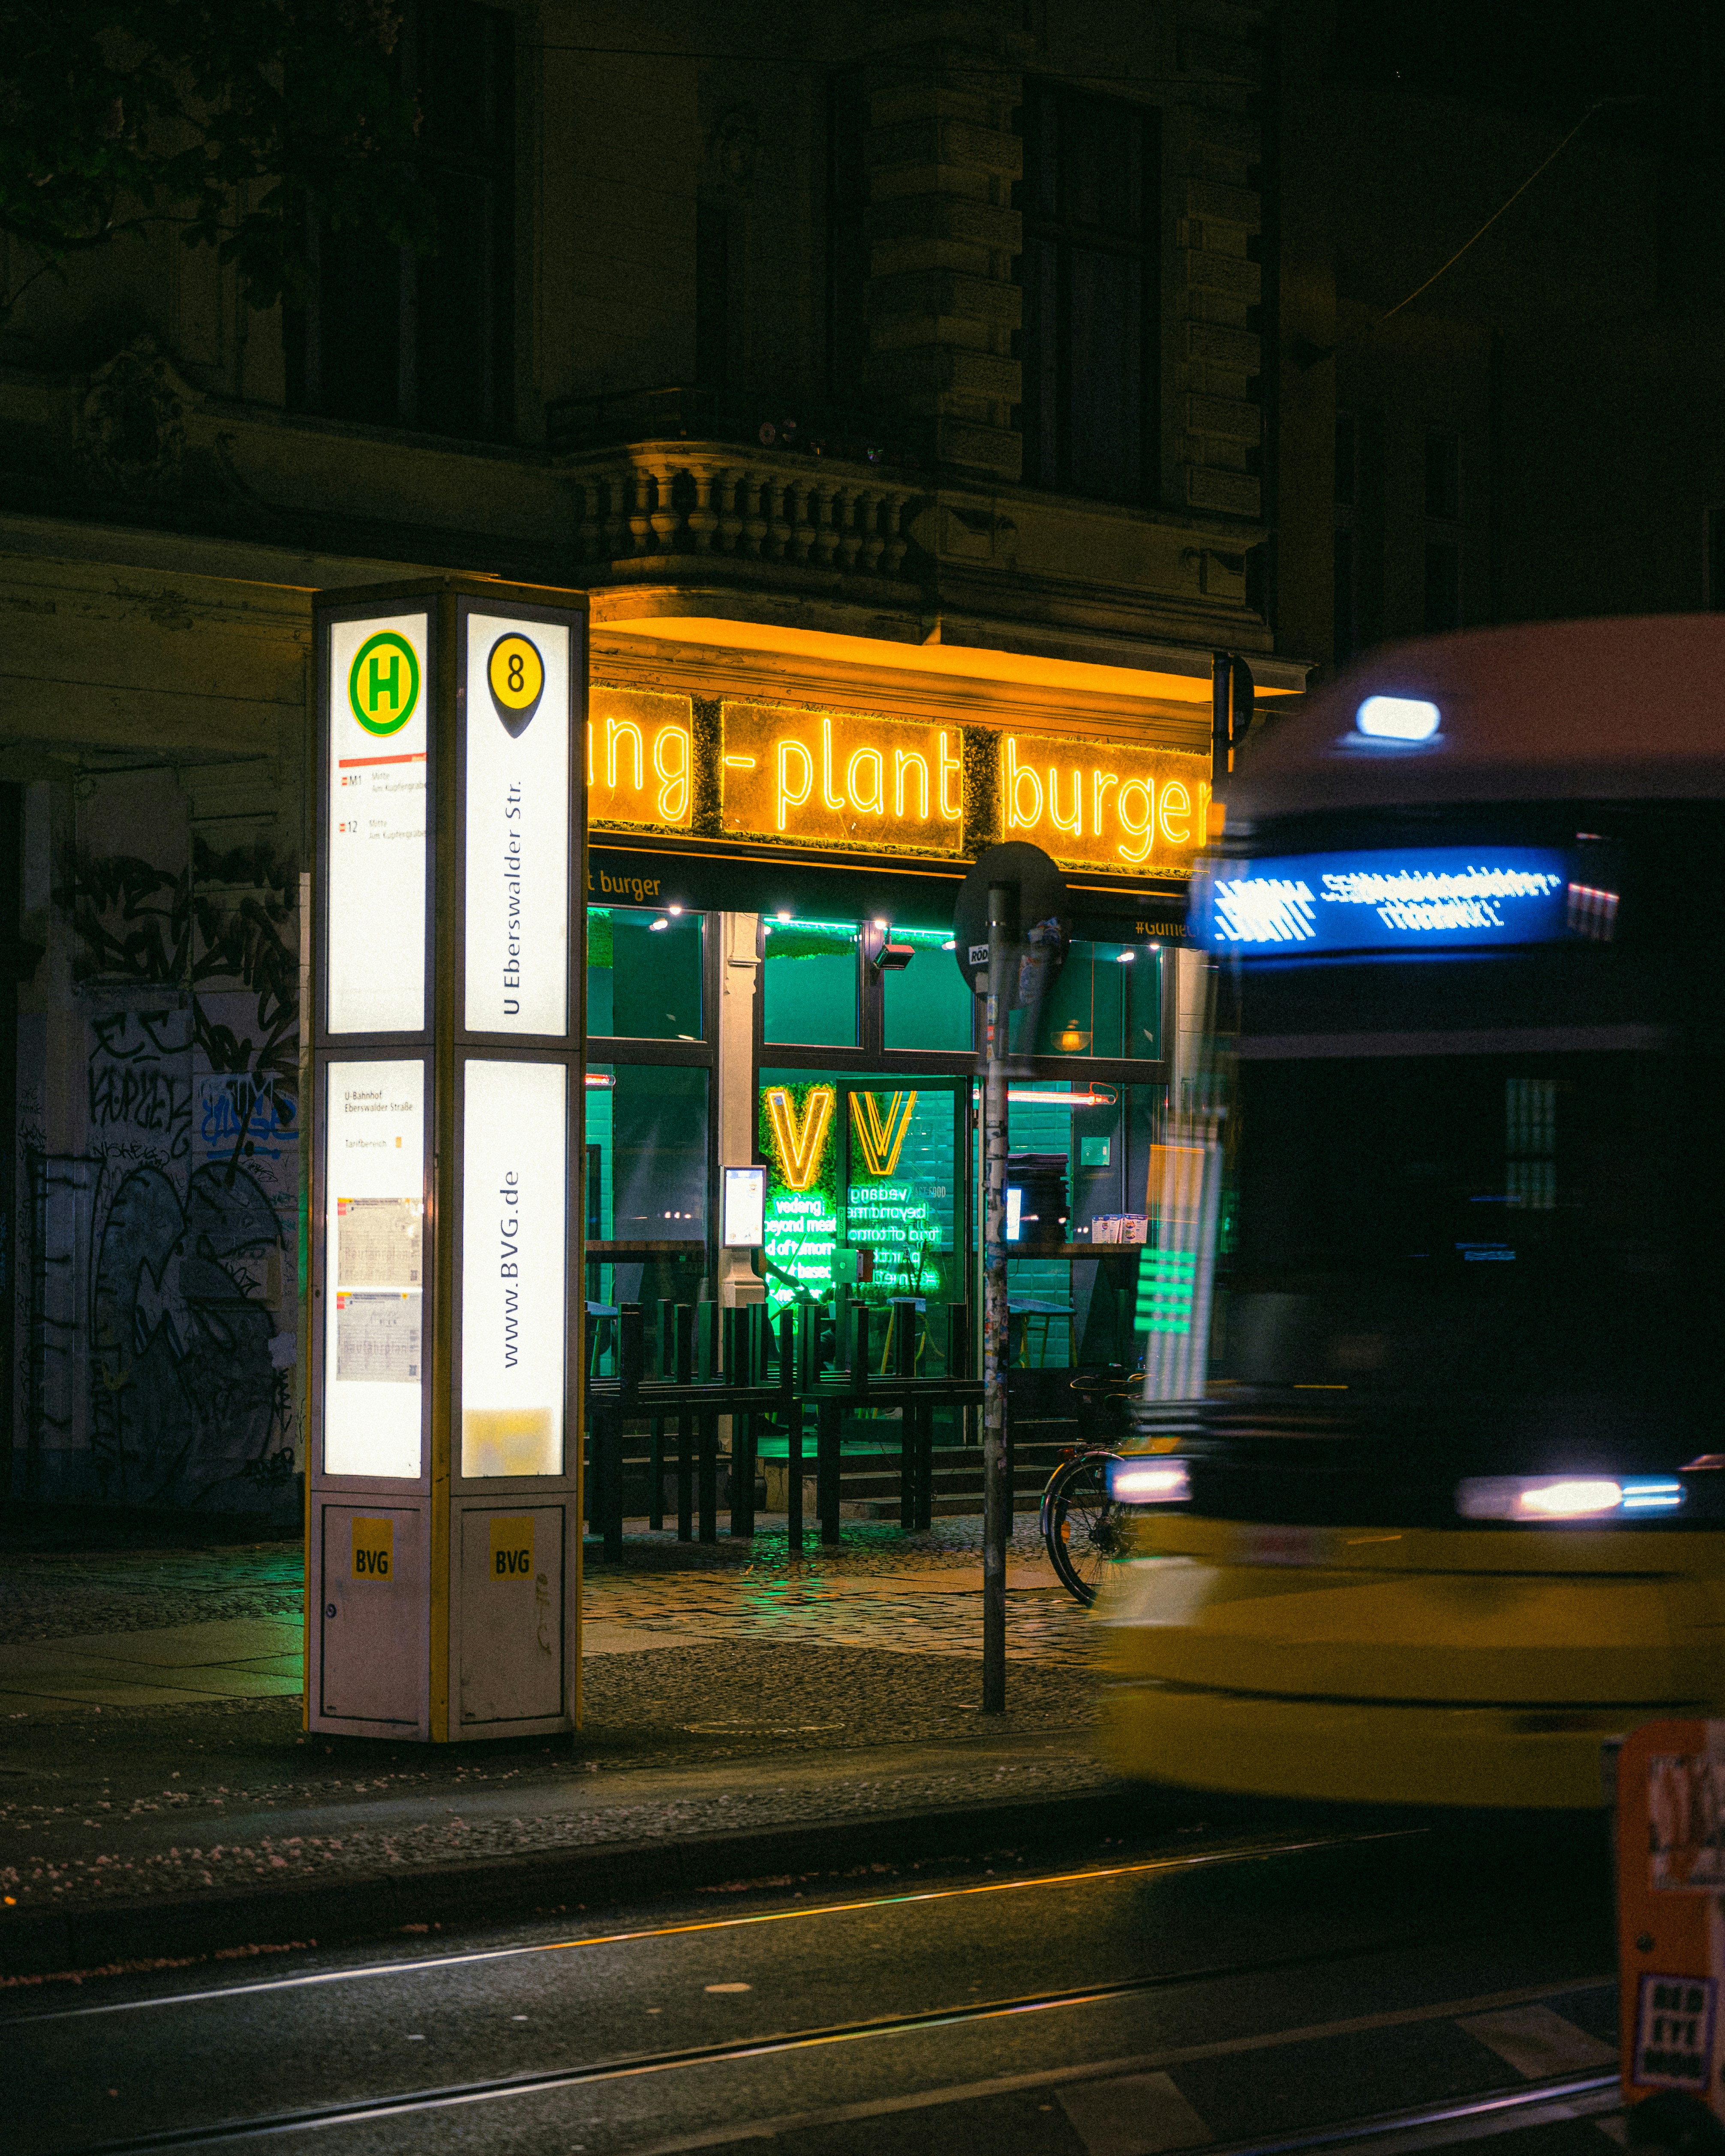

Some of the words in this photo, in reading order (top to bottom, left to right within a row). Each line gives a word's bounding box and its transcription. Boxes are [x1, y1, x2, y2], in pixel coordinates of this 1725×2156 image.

[369, 656, 400, 712] H
[508, 654, 524, 692] 8
[505, 781, 521, 820] Str.
[778, 718, 962, 830] plant
[1008, 737, 1212, 863] burger
[348, 820, 358, 832] 12
[601, 870, 661, 902] burger
[503, 829, 520, 988] Eberswalder
[503, 999, 520, 1015] U
[345, 1090, 382, 1100] U-Bahnhof
[345, 1103, 388, 1112] Eberswalder
[391, 1102, 413, 1111] Straße
[767, 1091, 831, 1187] V
[776, 1197, 822, 1217] vedang
[499, 1170, 520, 1369] www.BVG.de
[356, 1549, 388, 1575] BVG
[496, 1549, 530, 1574] BVG
